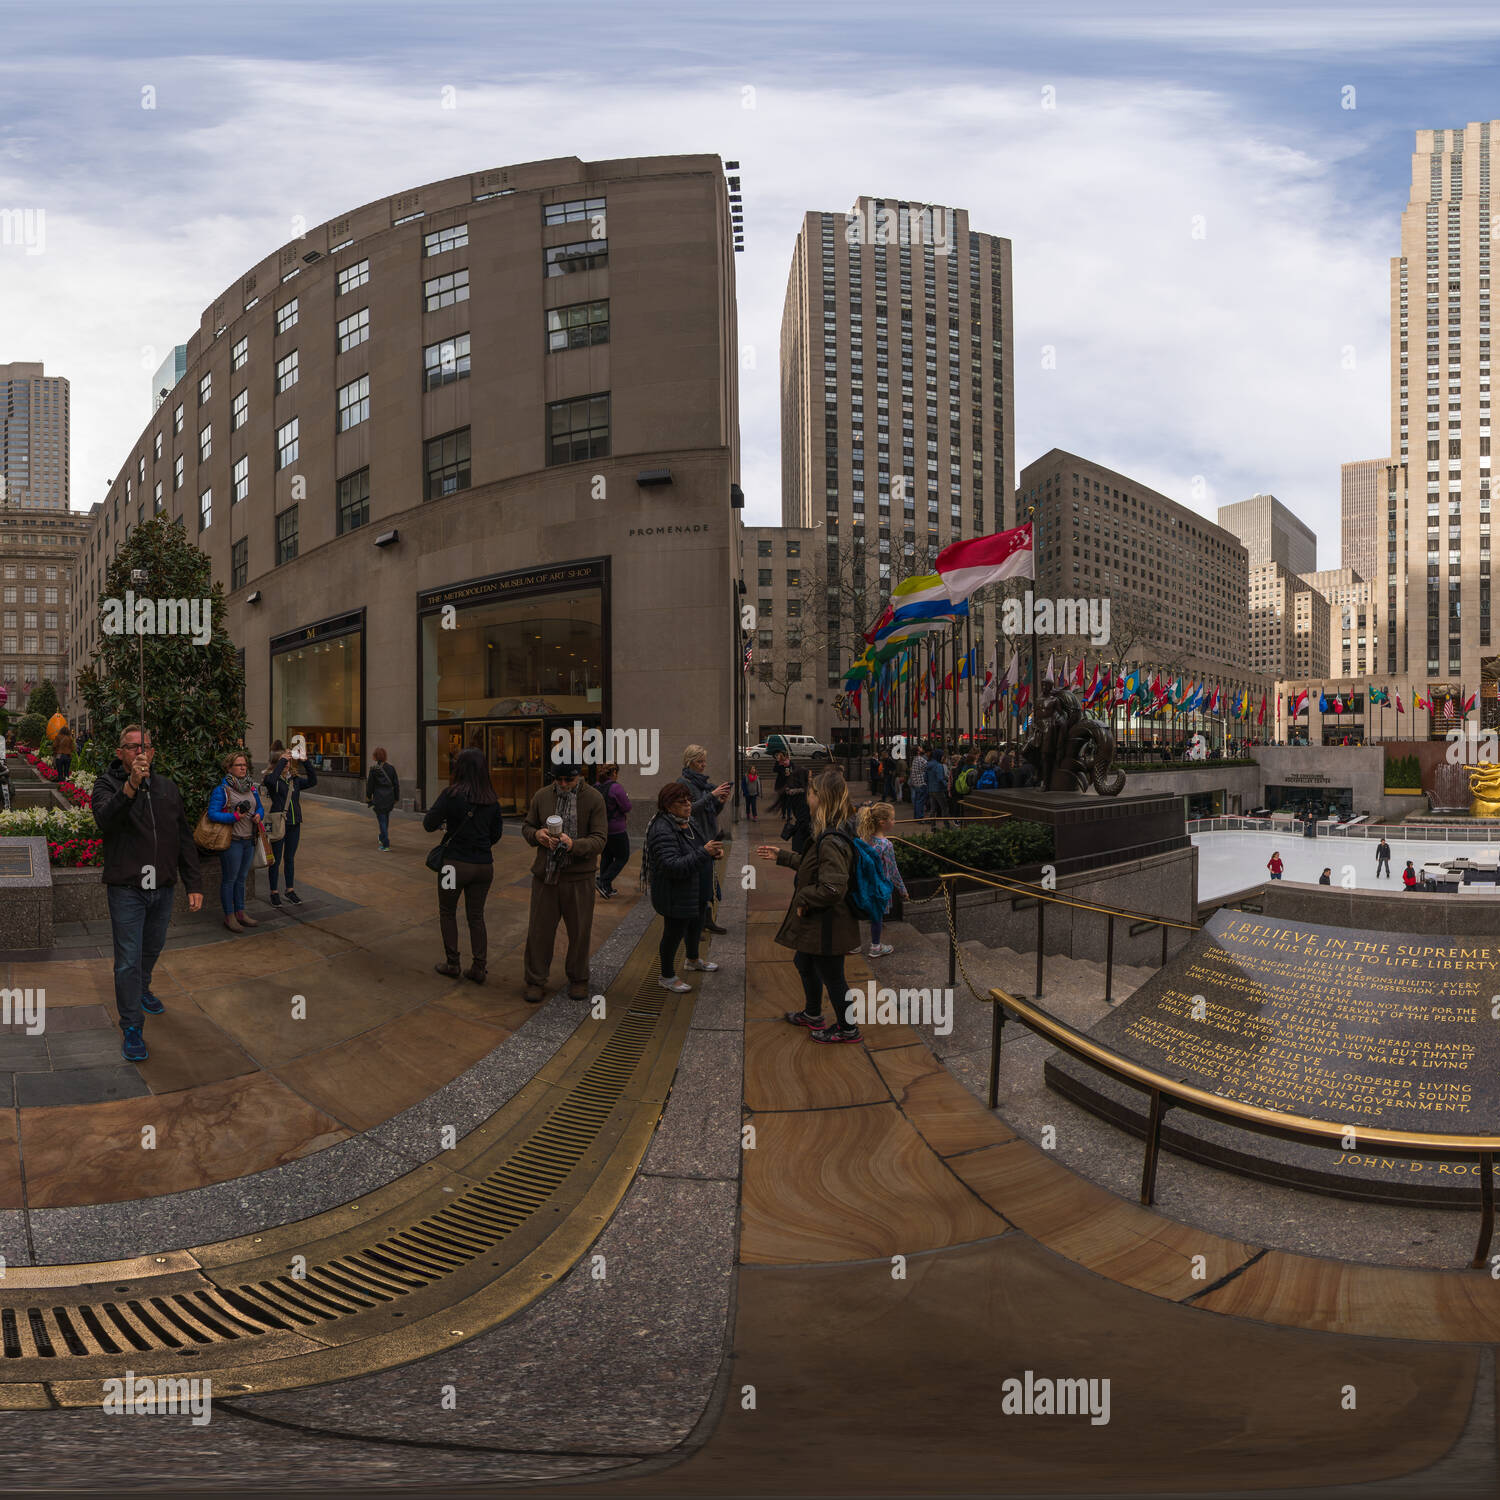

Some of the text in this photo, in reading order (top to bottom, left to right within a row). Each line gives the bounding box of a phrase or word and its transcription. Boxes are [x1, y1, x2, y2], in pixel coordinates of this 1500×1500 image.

[629, 524, 709, 536] PROMENADE
[428, 568, 592, 605] THE METROPOLITAN MUSEUM OF ART SHOP
[1219, 931, 1249, 943] AND
[1252, 937, 1269, 947] IN
[1272, 941, 1298, 952] HIS
[1303, 946, 1352, 960] RIGHT
[1360, 954, 1379, 964] TO
[1428, 959, 1498, 970] LIBERTY
[1226, 920, 1236, 930] I
[1238, 922, 1318, 945] BELIEVE
[1325, 937, 1347, 949] IN
[1354, 941, 1388, 954] THE
[1396, 945, 1489, 959] SUPREME
[1247, 995, 1380, 1024] AND NOT THEIR MASTER
[1124, 1027, 1176, 1053] FINANCIAL
[1255, 1073, 1322, 1096] WHETHER
[1328, 1090, 1344, 1099] IN
[1132, 1022, 1471, 1102] AND THAT ECONOMY IS A PRIME REQUISITE OF A SOUND
[1138, 1016, 1167, 1030] THAT
[1166, 1025, 1200, 1041] THRIFT
[1215, 1042, 1277, 1066] ESSENTIAL
[1282, 1060, 1298, 1070] TO
[1304, 1066, 1336, 1078] WELL
[1343, 1073, 1412, 1088] ORDERED
[1419, 1082, 1471, 1092] LIVING
[1215, 1021, 1239, 1032] MAN
[1242, 1029, 1256, 1037] AN
[1260, 1034, 1343, 1056] OPPORTUNITY
[1347, 1051, 1363, 1060] TO
[1367, 1054, 1404, 1065] MAKE
[1422, 1059, 1468, 1069] LIVING
[1249, 1042, 1321, 1065] I BELIEVE
[1165, 1054, 1382, 1115] BUSINESS OR PERSONAL AFFAIRS
[1334, 1153, 1394, 1168] JOHN
[1408, 1161, 1423, 1172] D
